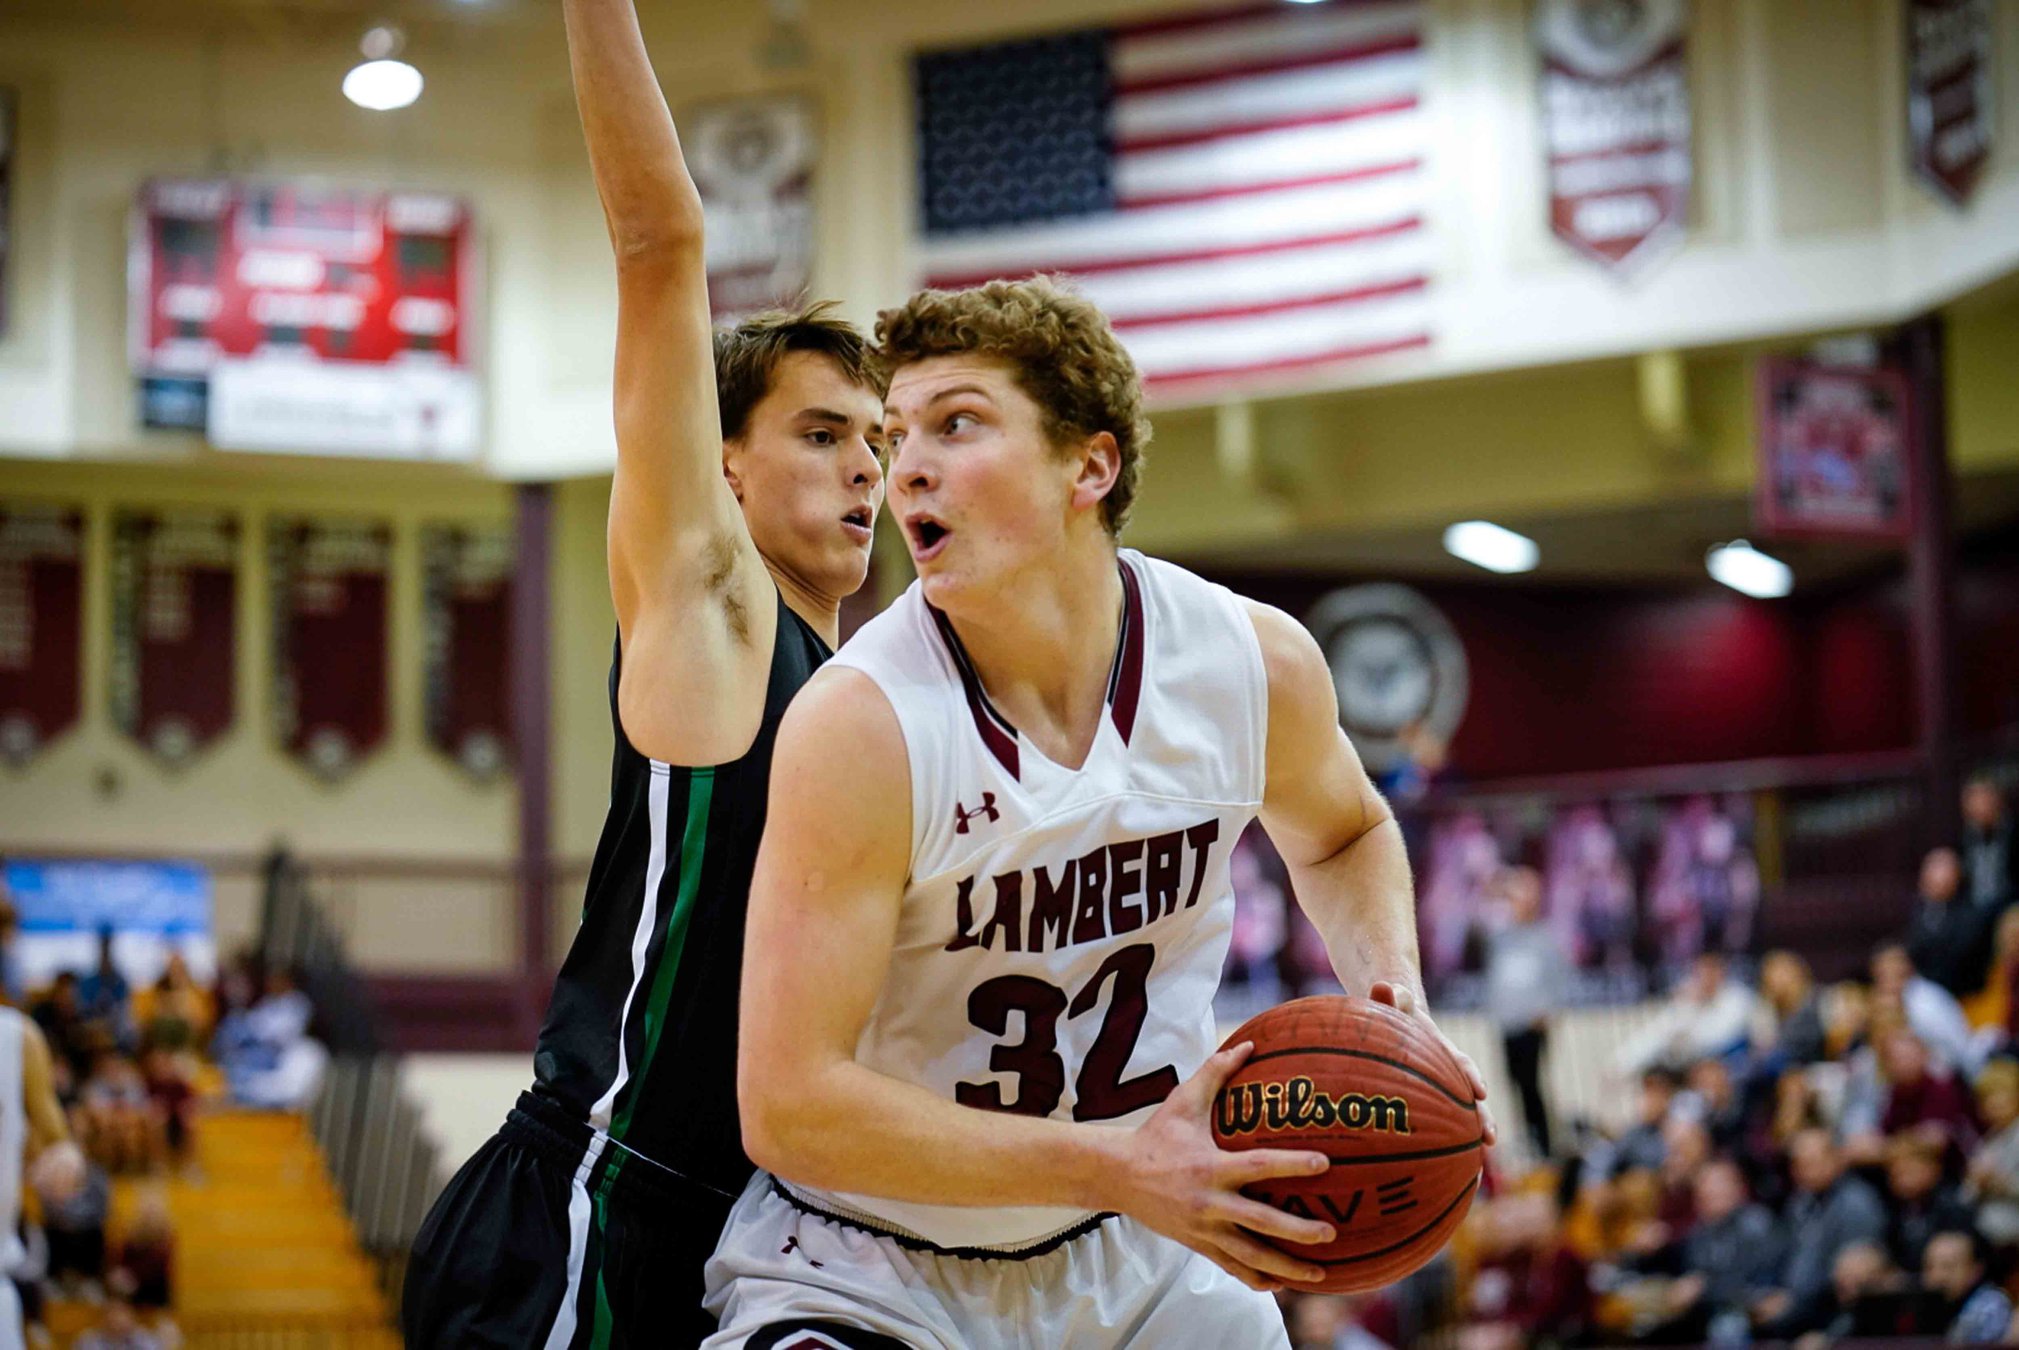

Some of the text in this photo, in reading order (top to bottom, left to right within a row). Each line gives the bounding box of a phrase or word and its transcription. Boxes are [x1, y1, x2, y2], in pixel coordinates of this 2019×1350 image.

[944, 818, 1219, 952] LAMBERT
[955, 943, 1179, 1122] 32
[1216, 1075, 1411, 1136] Wilson
[1261, 1176, 1418, 1223] AVE
